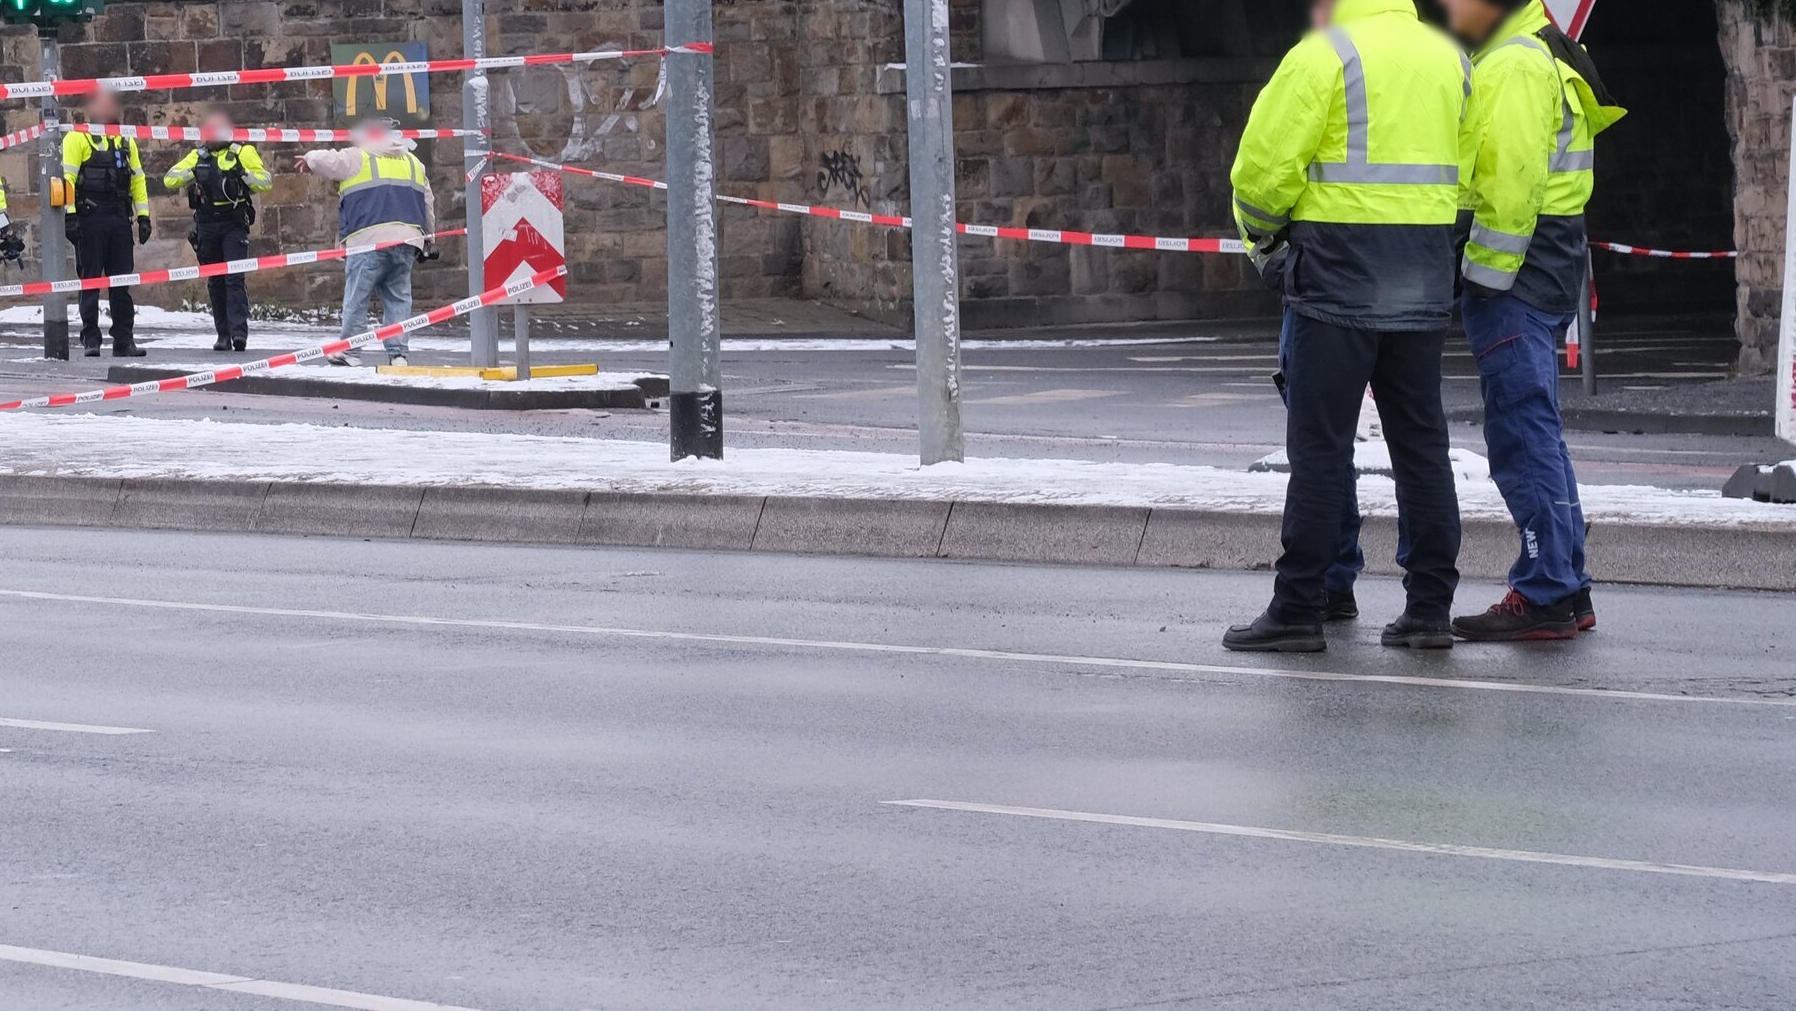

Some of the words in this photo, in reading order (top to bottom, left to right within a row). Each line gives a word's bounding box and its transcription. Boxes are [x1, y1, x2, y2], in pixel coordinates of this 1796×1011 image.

[77, 393, 103, 401] POLIZEI
[133, 384, 158, 393] POLIZEI
[188, 373, 213, 384] POLIZEI
[243, 362, 268, 372] POLIZEI
[296, 347, 322, 359] POLIZEI
[350, 333, 375, 345] POLIZEI
[403, 316, 428, 330] POLIZEI
[455, 299, 480, 313] POLIZEI
[507, 281, 532, 295] POLIZEI
[1525, 529, 1539, 558] NEW
